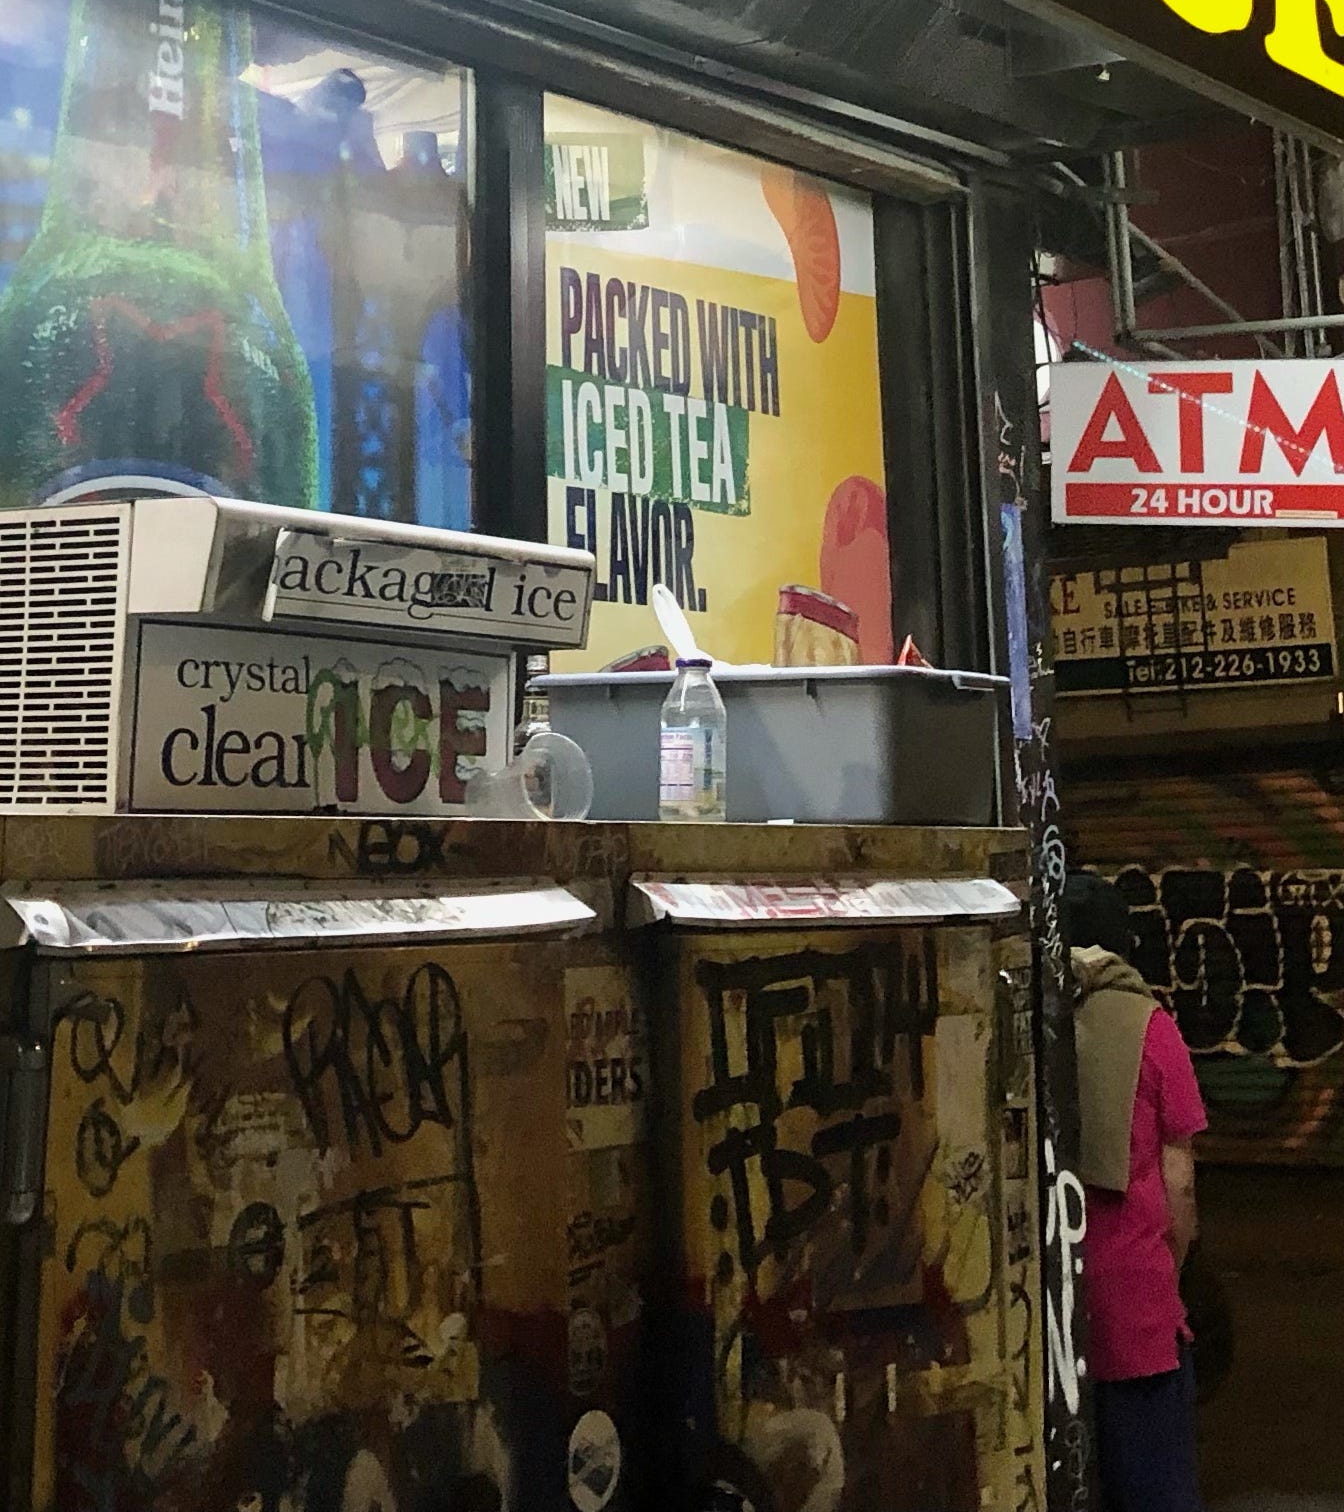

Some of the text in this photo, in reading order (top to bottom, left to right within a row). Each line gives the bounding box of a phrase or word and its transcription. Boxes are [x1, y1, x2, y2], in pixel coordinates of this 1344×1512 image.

[553, 144, 612, 223] NEW
[560, 265, 781, 418] PACKED WITH
[561, 378, 738, 506] ICED TEA
[1129, 488, 1274, 515] 24 HOUR
[565, 486, 708, 612] FLAVOR.
[509, 572, 577, 622] ice
[1222, 587, 1297, 611] SERVICE
[176, 654, 310, 703] crystal
[160, 703, 311, 789] clear
[332, 658, 492, 804] ICE
